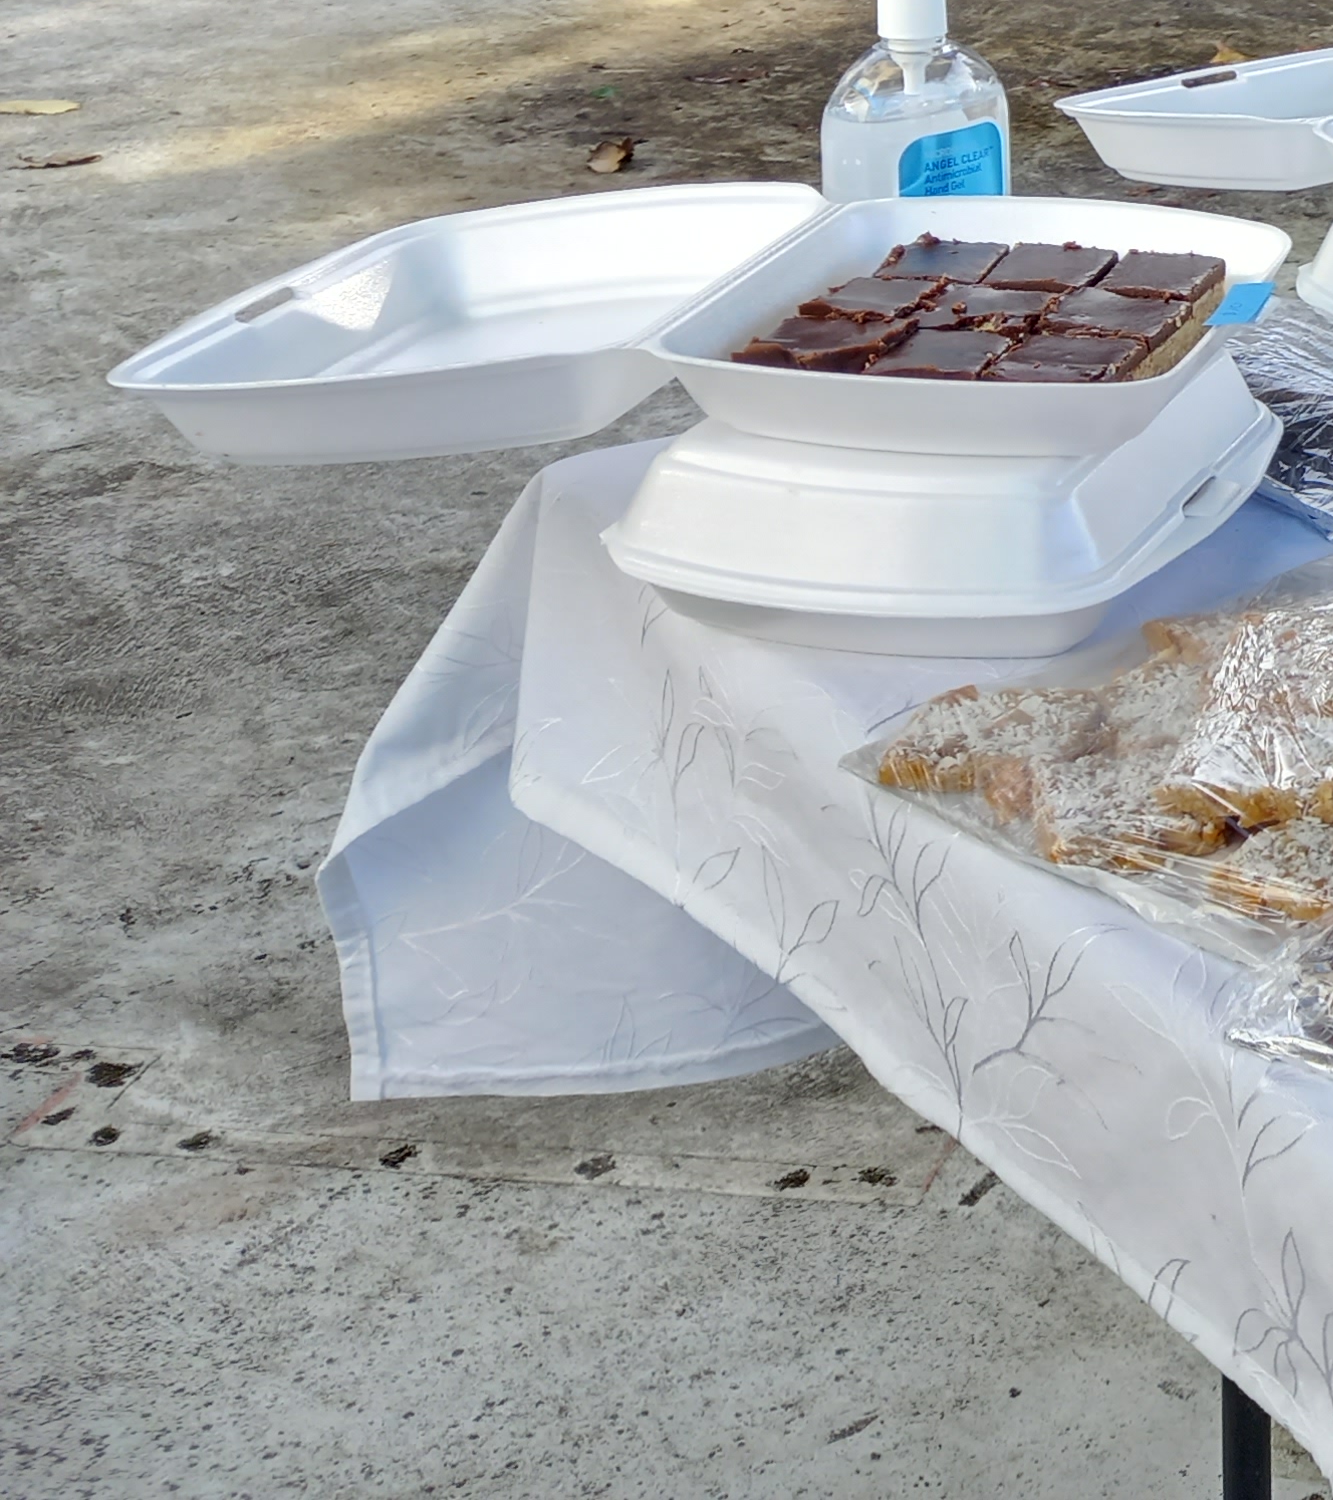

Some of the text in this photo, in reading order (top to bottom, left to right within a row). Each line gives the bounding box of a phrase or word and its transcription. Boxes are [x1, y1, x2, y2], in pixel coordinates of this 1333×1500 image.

[924, 157, 959, 173] ANGEL
[924, 164, 982, 185] Antimicrobial
[924, 181, 965, 196] Hand Gel
